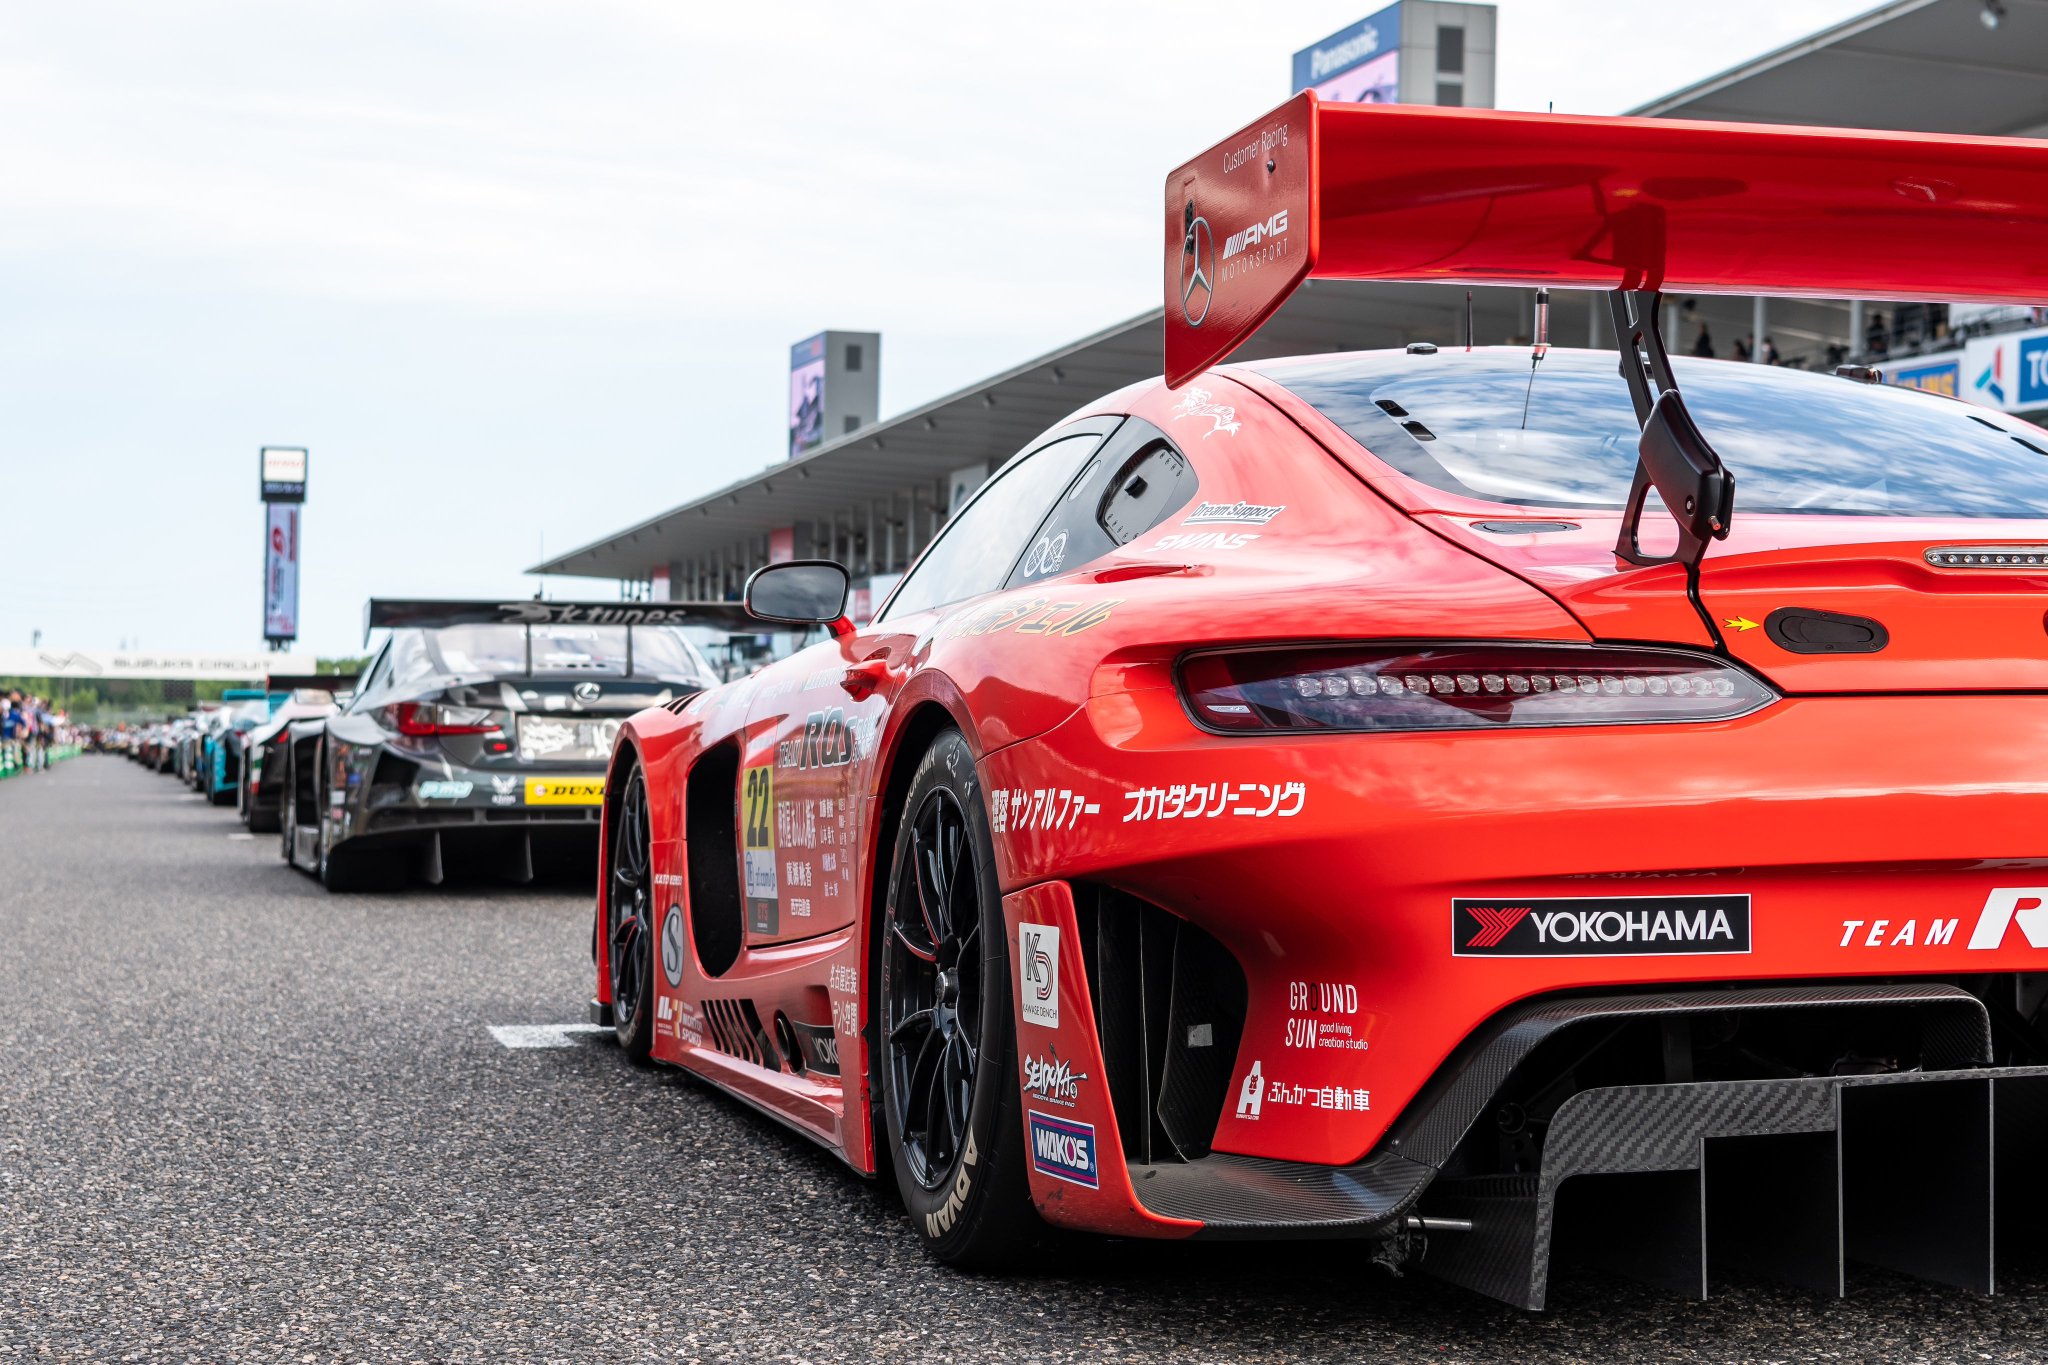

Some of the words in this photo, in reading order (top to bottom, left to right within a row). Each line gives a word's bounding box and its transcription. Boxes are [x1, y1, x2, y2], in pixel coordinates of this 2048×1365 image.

[1311, 24, 1379, 80] Panasonic
[1223, 140, 1260, 174] Customer
[1262, 124, 1288, 153] Racing
[1243, 209, 1288, 251] AMG
[1221, 238, 1288, 283] MOTORSPORT
[1191, 503, 1230, 517] Dream
[1228, 502, 1283, 519] Support
[747, 768, 769, 847] 22
[1122, 782, 1306, 823] オカダクリーニング
[1529, 908, 1735, 944] YOKOHAMA
[1839, 918, 1959, 947] TEAM
[1289, 981, 1358, 1014] GROUND
[1285, 1017, 1318, 1049] SUN
[1318, 1037, 1345, 1048] creation
[1345, 1038, 1369, 1050] studio
[1319, 1023, 1335, 1035] good
[1335, 1022, 1352, 1037] living
[1268, 1081, 1371, 1112] ぶんかつ自動車
[926, 1124, 978, 1238] ADVAN
